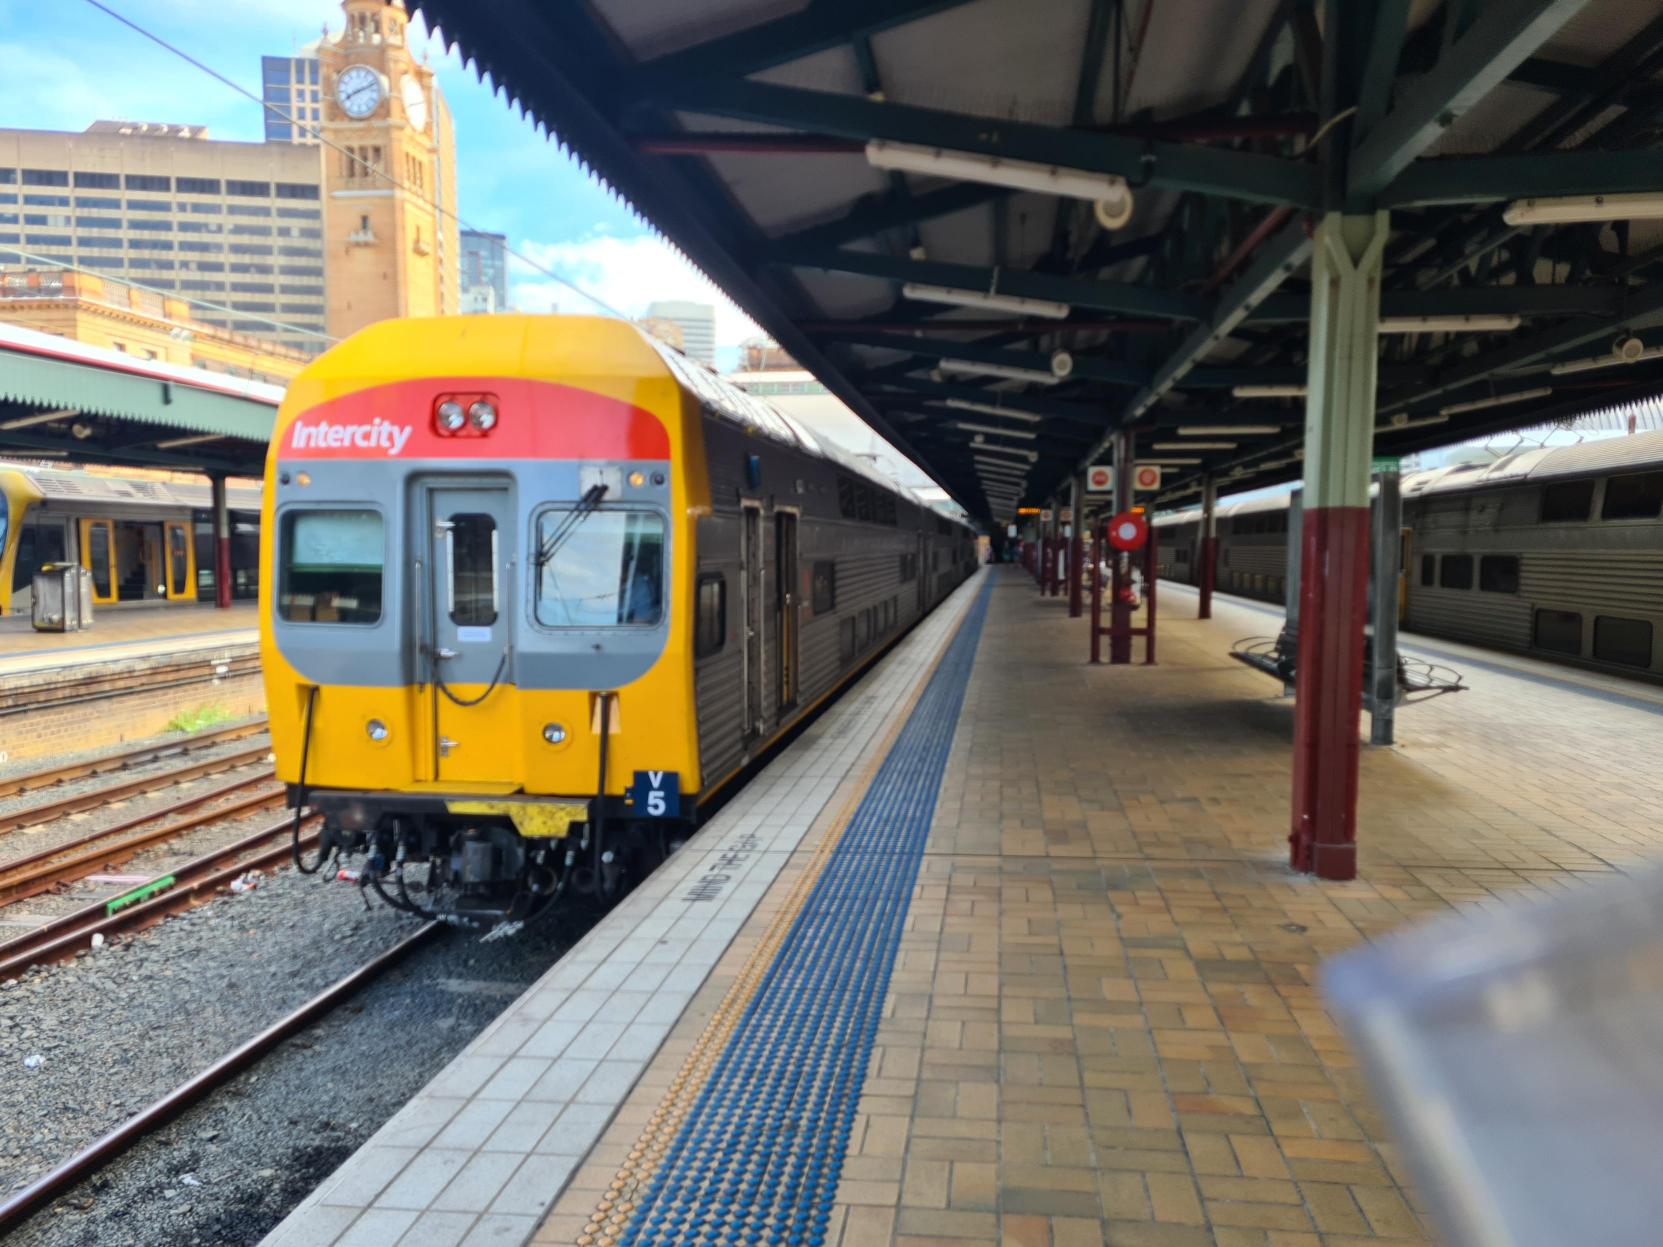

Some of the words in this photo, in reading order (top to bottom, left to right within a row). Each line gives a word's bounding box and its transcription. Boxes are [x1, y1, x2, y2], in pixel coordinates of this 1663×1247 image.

[291, 417, 412, 455] Intercity
[648, 770, 664, 789] V
[647, 790, 666, 816] 5
[681, 873, 731, 902] MIND
[709, 853, 750, 871] THE
